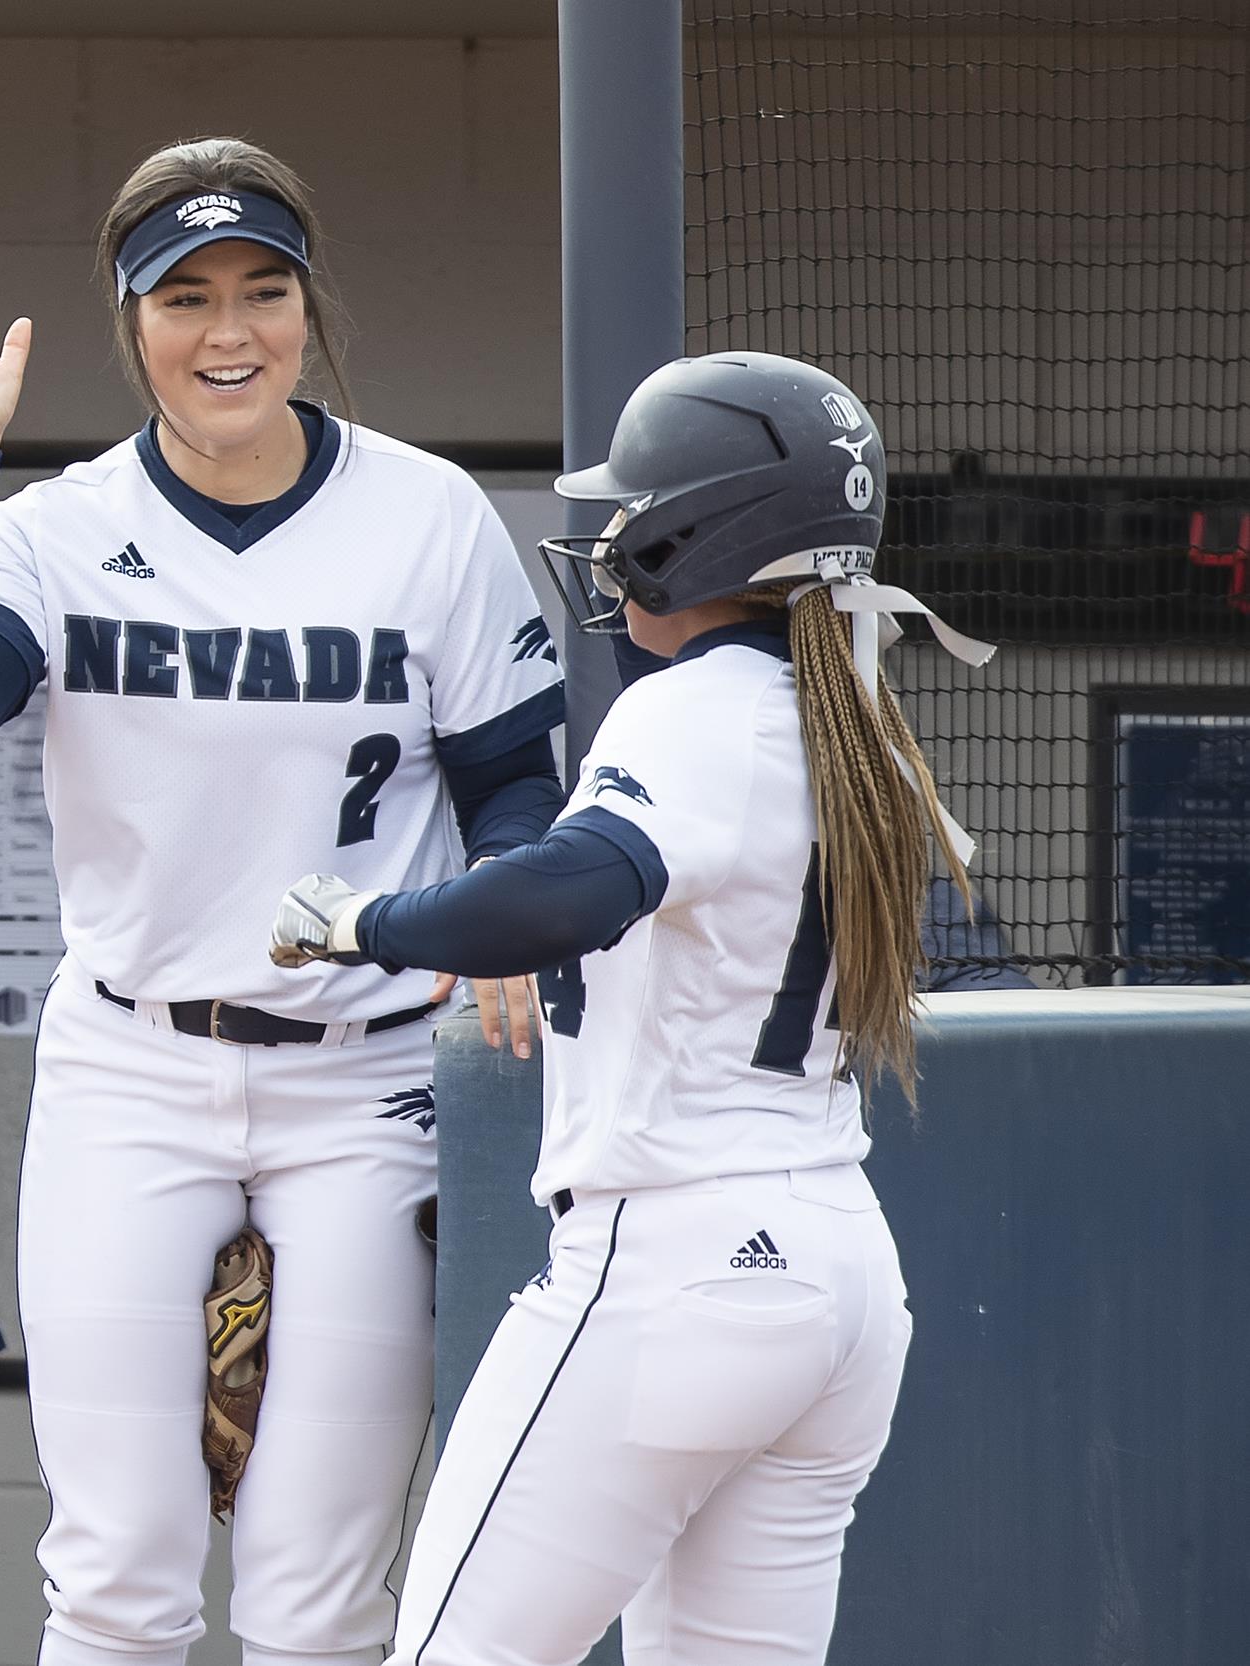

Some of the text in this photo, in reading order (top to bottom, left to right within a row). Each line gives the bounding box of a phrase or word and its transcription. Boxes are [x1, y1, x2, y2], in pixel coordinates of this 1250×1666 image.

[175, 194, 243, 221] NEVADA
[853, 476, 867, 498] 14
[101, 561, 156, 579] adidas
[63, 613, 410, 705] NEVADA
[335, 732, 402, 848] 2
[729, 1252, 788, 1271] adidas
